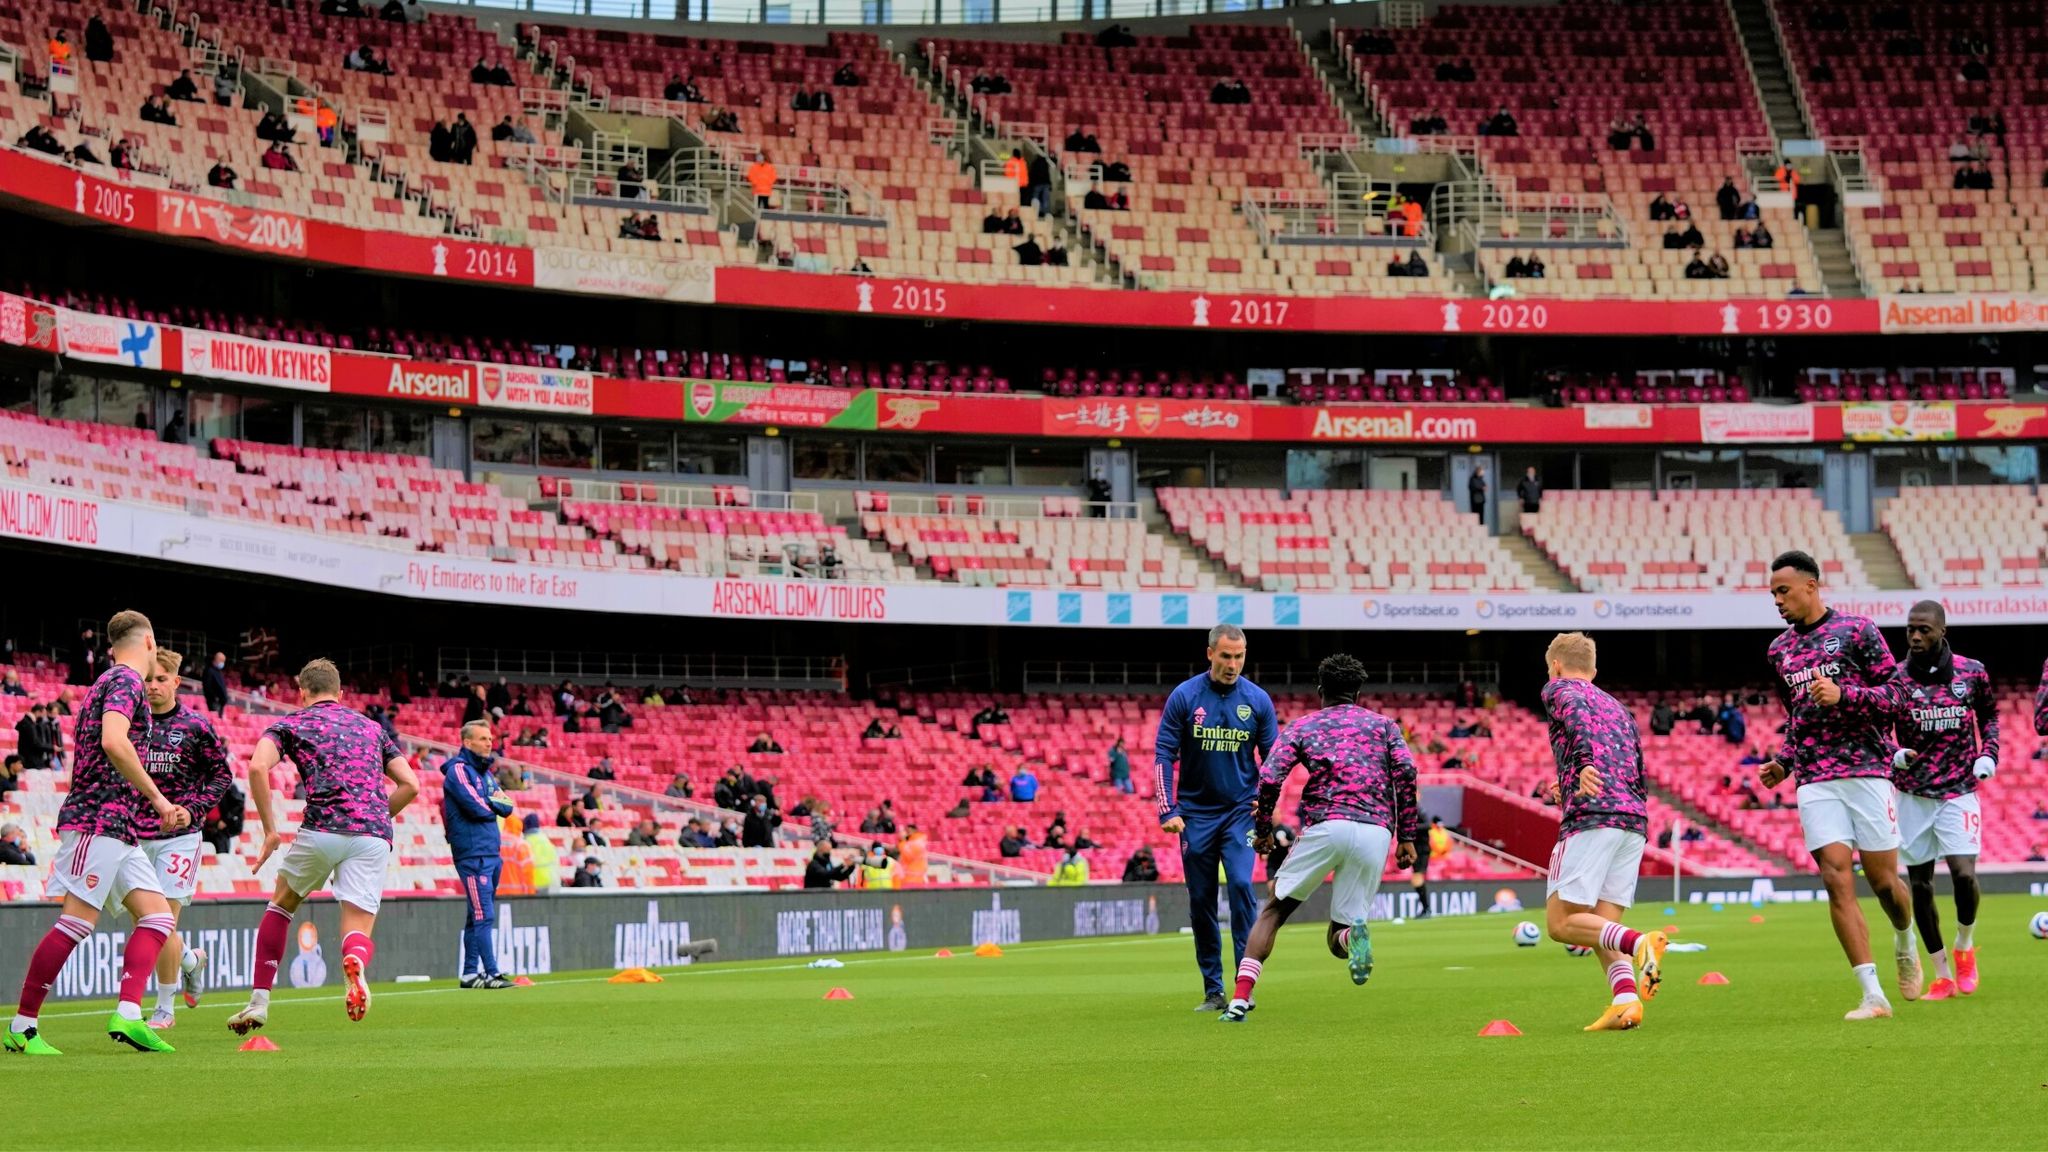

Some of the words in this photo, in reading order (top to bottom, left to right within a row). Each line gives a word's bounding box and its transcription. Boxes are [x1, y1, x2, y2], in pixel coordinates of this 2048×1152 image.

[93, 184, 135, 224] 2005
[247, 213, 305, 251] 2004
[465, 247, 518, 279] 2014
[541, 252, 573, 270] YOU
[891, 285, 947, 313] 2015
[1229, 300, 1289, 326] 2017
[1482, 304, 1548, 329] 2020
[1757, 304, 1832, 330] 1930
[1886, 299, 1974, 326] Arsenal
[211, 338, 268, 376] MILTON
[271, 348, 328, 384] KEYNES
[388, 363, 470, 400] Arsenal
[506, 386, 529, 402] WITH
[1312, 410, 1478, 440] Arsenal.com
[408, 561, 428, 592] Fly
[431, 563, 486, 592] Emirates
[490, 572, 503, 592] to
[507, 572, 526, 595] the
[530, 573, 549, 596] Far
[552, 575, 578, 598] East
[713, 581, 885, 619] ARSENAL.COM/TOURS
[1383, 601, 1460, 618] Sportsbet.io
[1497, 601, 1576, 618] Sportsbet.io
[1614, 601, 1693, 618] Sportsbet.io
[1822, 598, 1904, 616] mirates
[1194, 715, 1205, 725] SF
[1911, 704, 1968, 723] Emirates
[1920, 719, 1934, 731] FLY
[1193, 724, 1250, 742] Emirates
[1201, 739, 1215, 751] FLY
[1216, 740, 1241, 752] BETTER
[146, 749, 182, 763] irates
[1962, 810, 1979, 835] 19
[166, 852, 192, 881] 32
[777, 910, 811, 955] MORE
